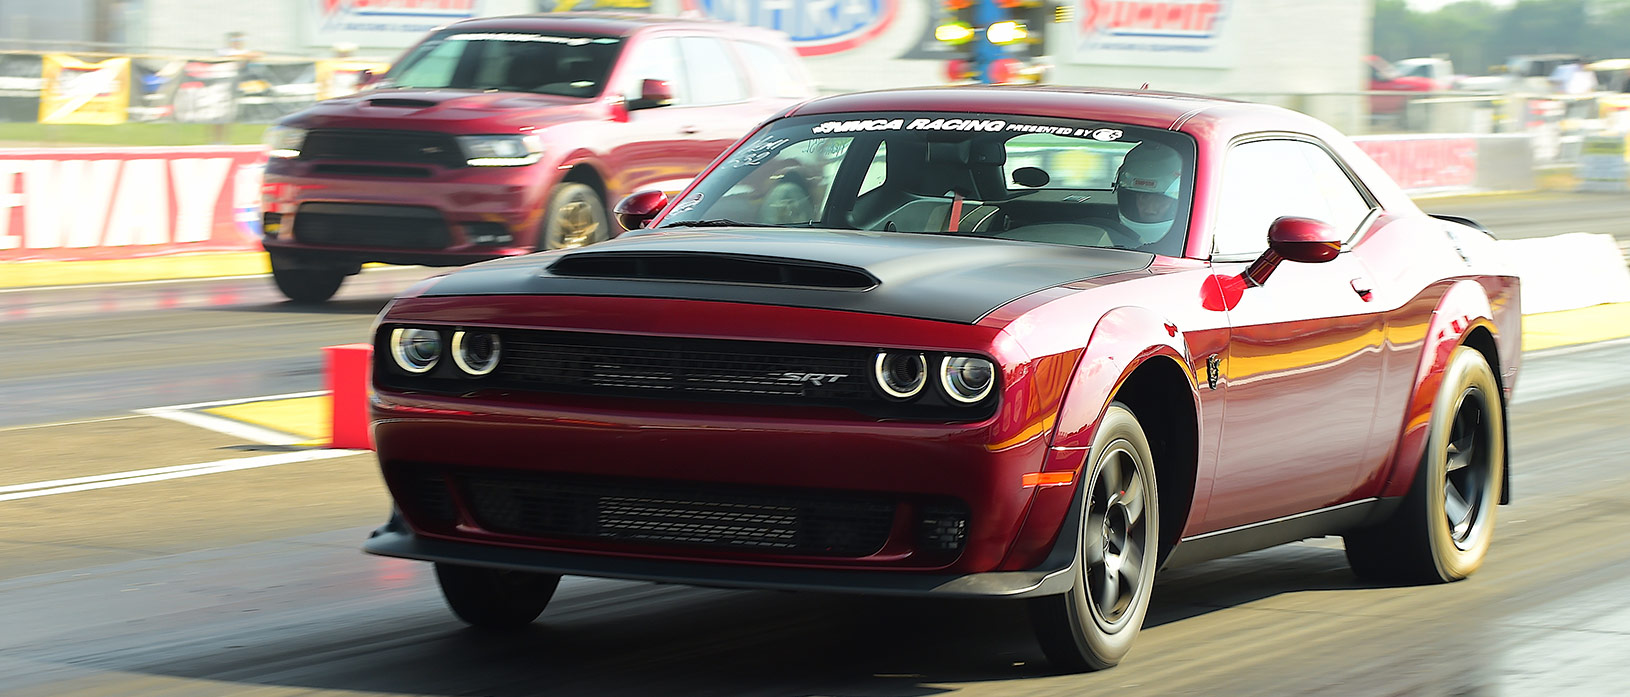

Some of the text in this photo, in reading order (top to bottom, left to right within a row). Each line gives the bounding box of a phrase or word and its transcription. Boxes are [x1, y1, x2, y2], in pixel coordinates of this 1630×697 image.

[905, 118, 1006, 132] RACING
[1005, 123, 1073, 136] PRESENTED
[1073, 129, 1094, 138] BY
[777, 372, 849, 386] SRT
